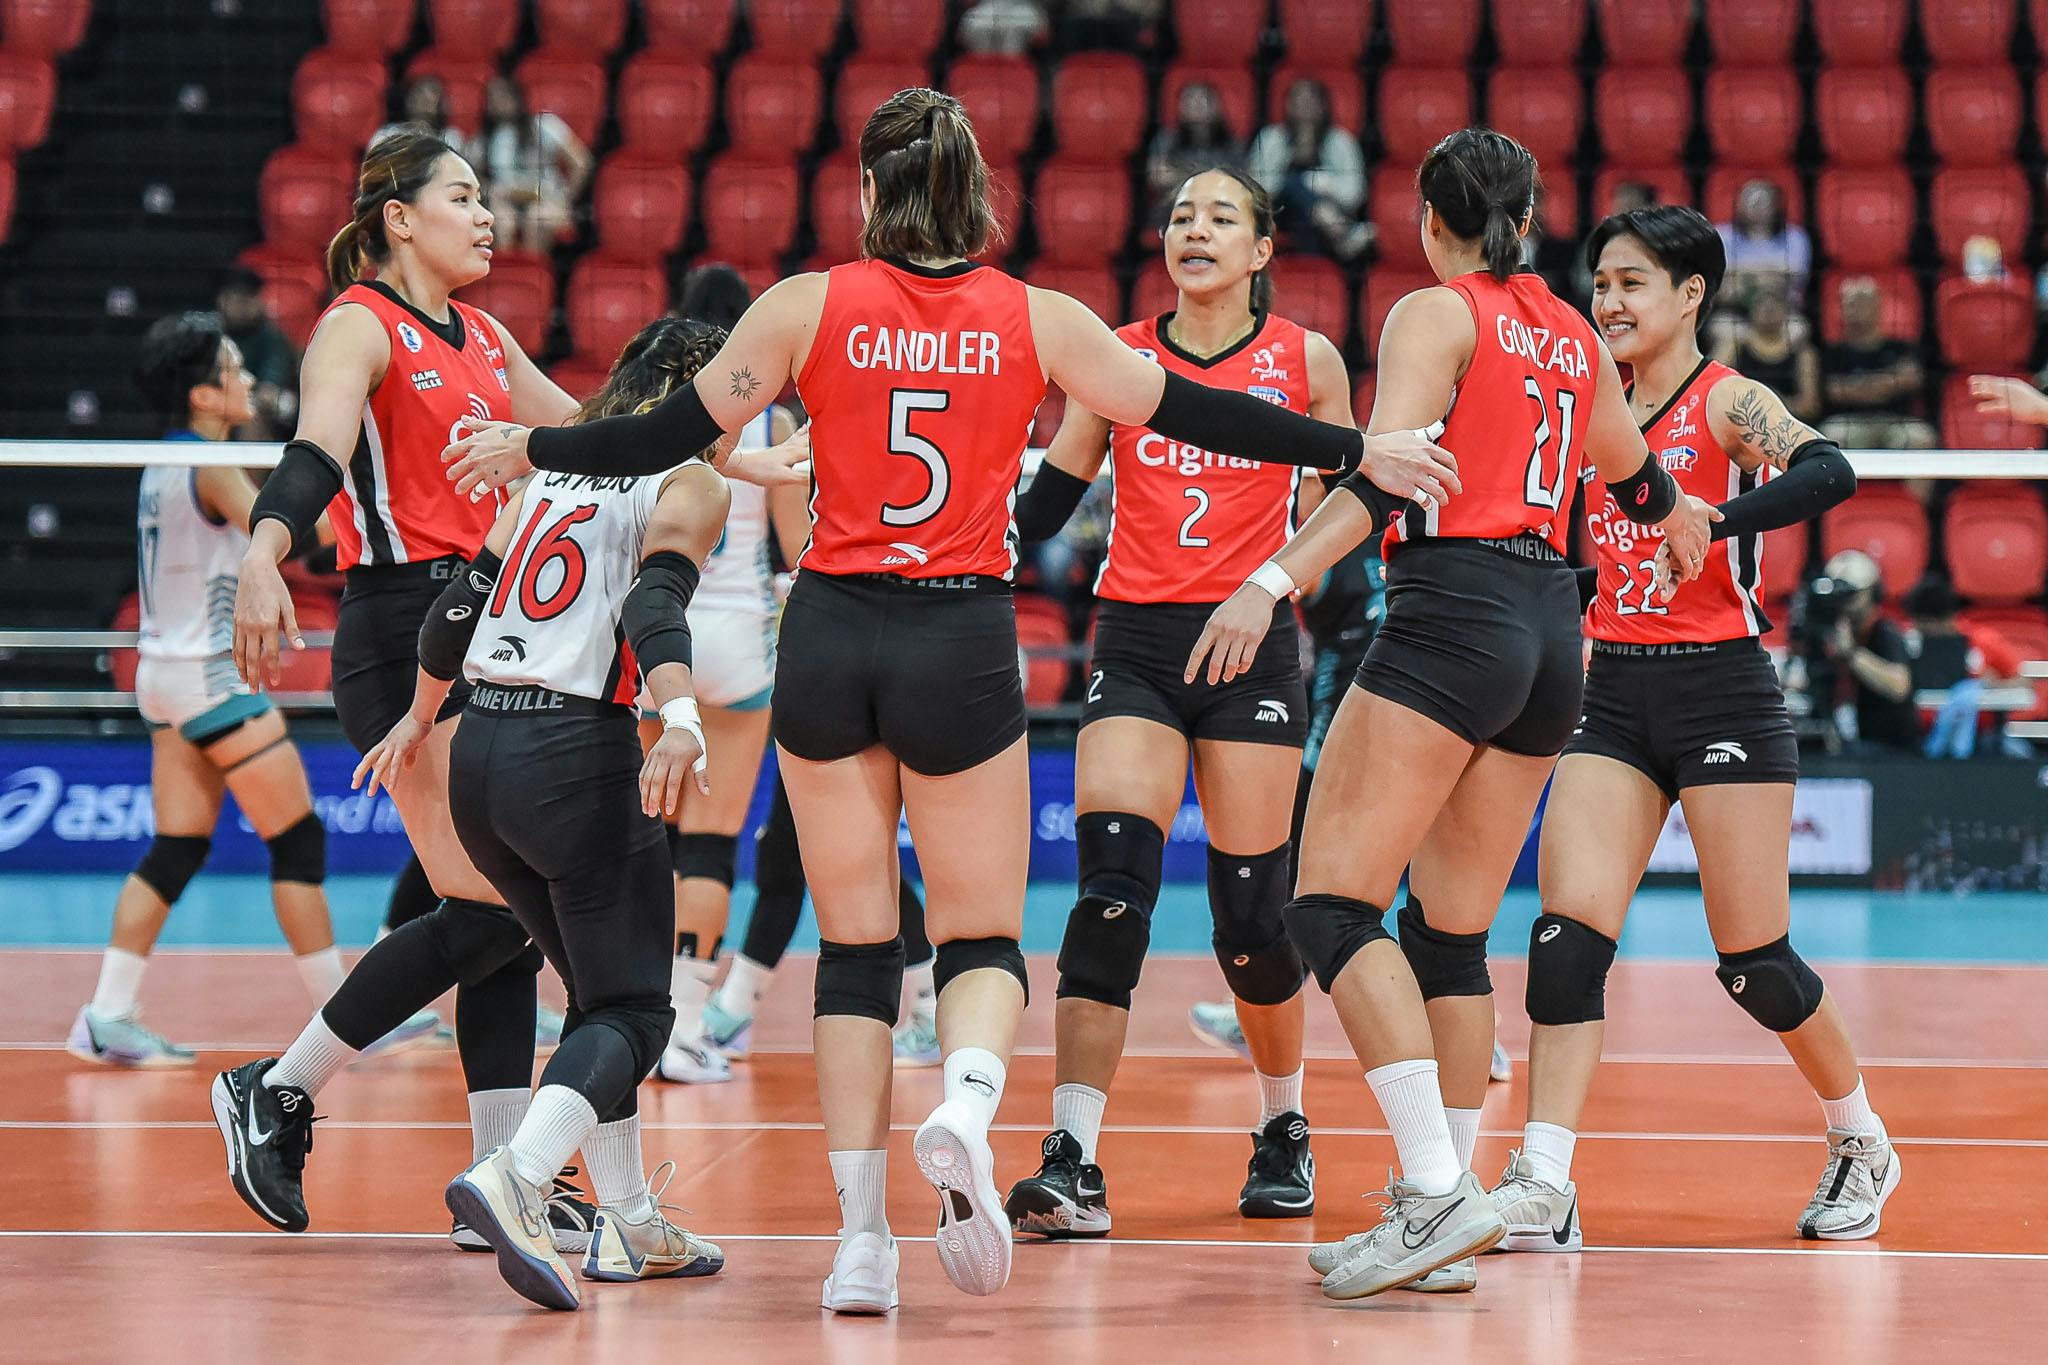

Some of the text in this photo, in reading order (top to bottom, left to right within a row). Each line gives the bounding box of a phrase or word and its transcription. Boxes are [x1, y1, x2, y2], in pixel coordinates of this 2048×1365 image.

[846, 324, 1001, 376] GANDLER
[1496, 314, 1591, 380] GONZAGA
[410, 369, 439, 382] GAME
[414, 378, 443, 391] VILLE
[879, 387, 951, 528] 5
[1523, 375, 1576, 516] 21
[1178, 487, 1210, 548] 2
[1587, 512, 1666, 552] Cigna
[488, 498, 600, 623] 16
[1615, 559, 1668, 616] 22
[488, 649, 514, 662] ANTA
[468, 685, 564, 711] AMEVILLE
[1087, 670, 1104, 704] 2
[1255, 710, 1279, 724] ANTA
[1703, 752, 1730, 764] ANTA
